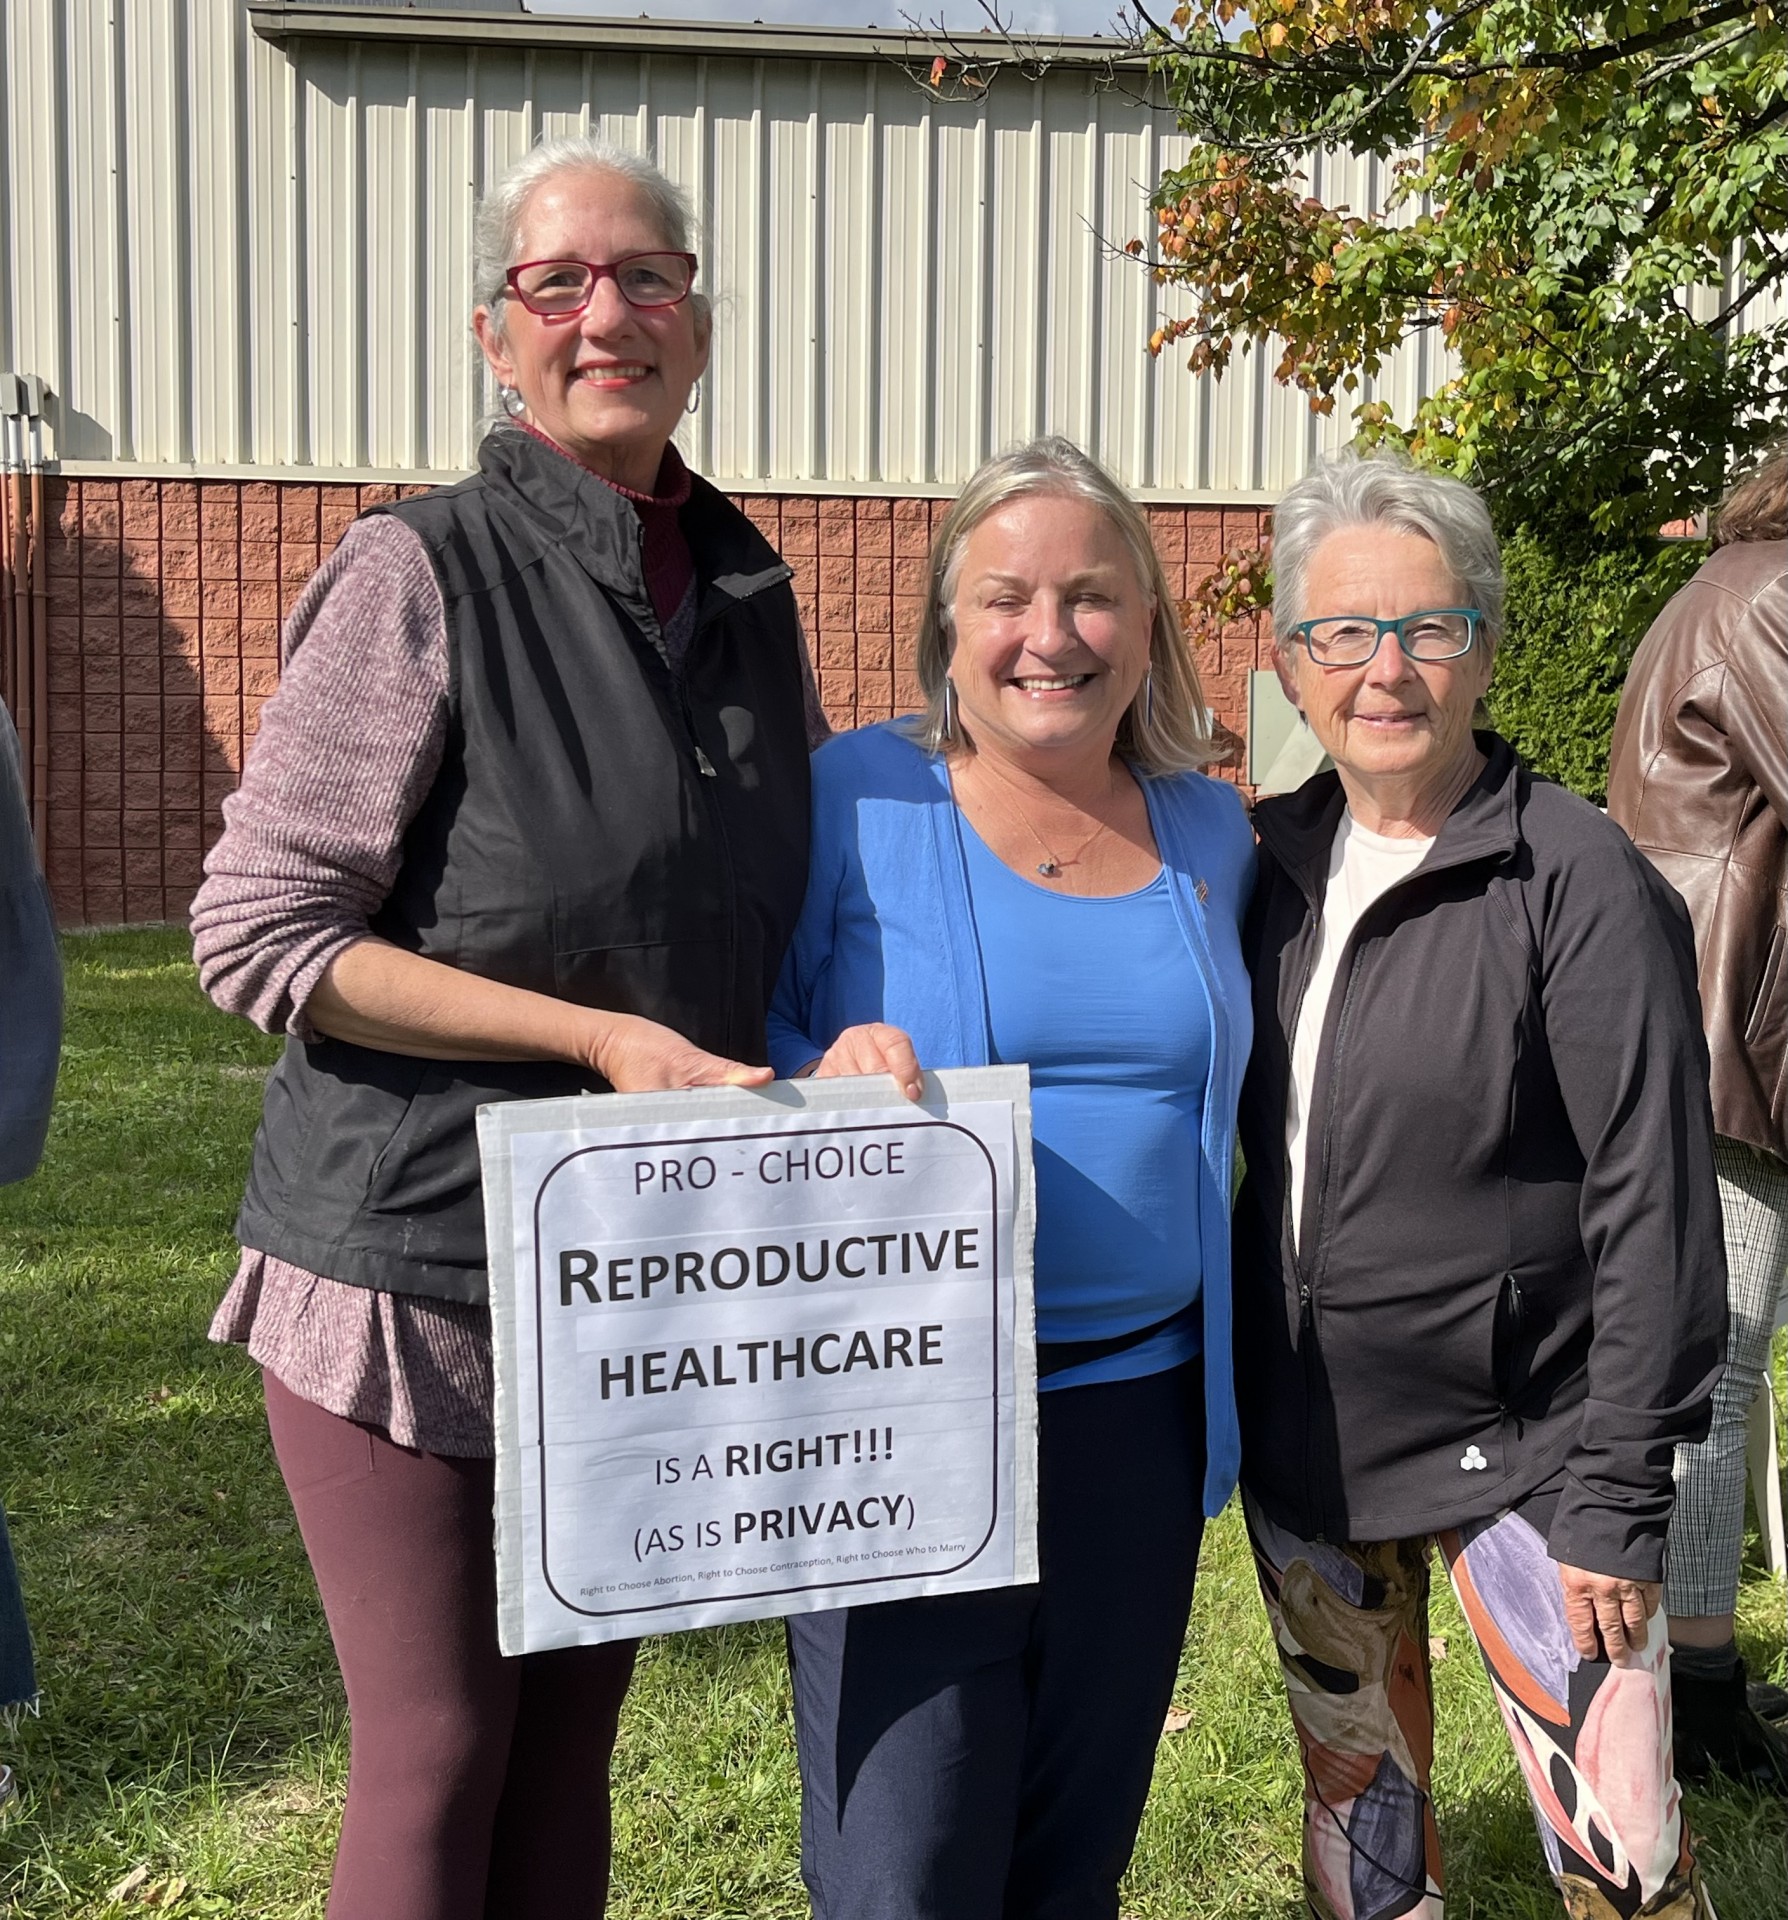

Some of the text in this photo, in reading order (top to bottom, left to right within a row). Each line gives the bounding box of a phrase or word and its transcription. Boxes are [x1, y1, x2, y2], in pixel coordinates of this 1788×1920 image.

[634, 1155, 717, 1195] PRO
[758, 1142, 905, 1185] CHOICE
[559, 1227, 979, 1306] REPRODUCTIVE
[600, 1324, 943, 1400] HEALTHCARE
[656, 1426, 894, 1485] IS A RIGHT!!!
[633, 1493, 915, 1562] (AS IS PRIVACY)
[580, 1543, 966, 1596] Right to Choose Abortion, Right to Choose Contraception, Right to Choose Who to Marry
